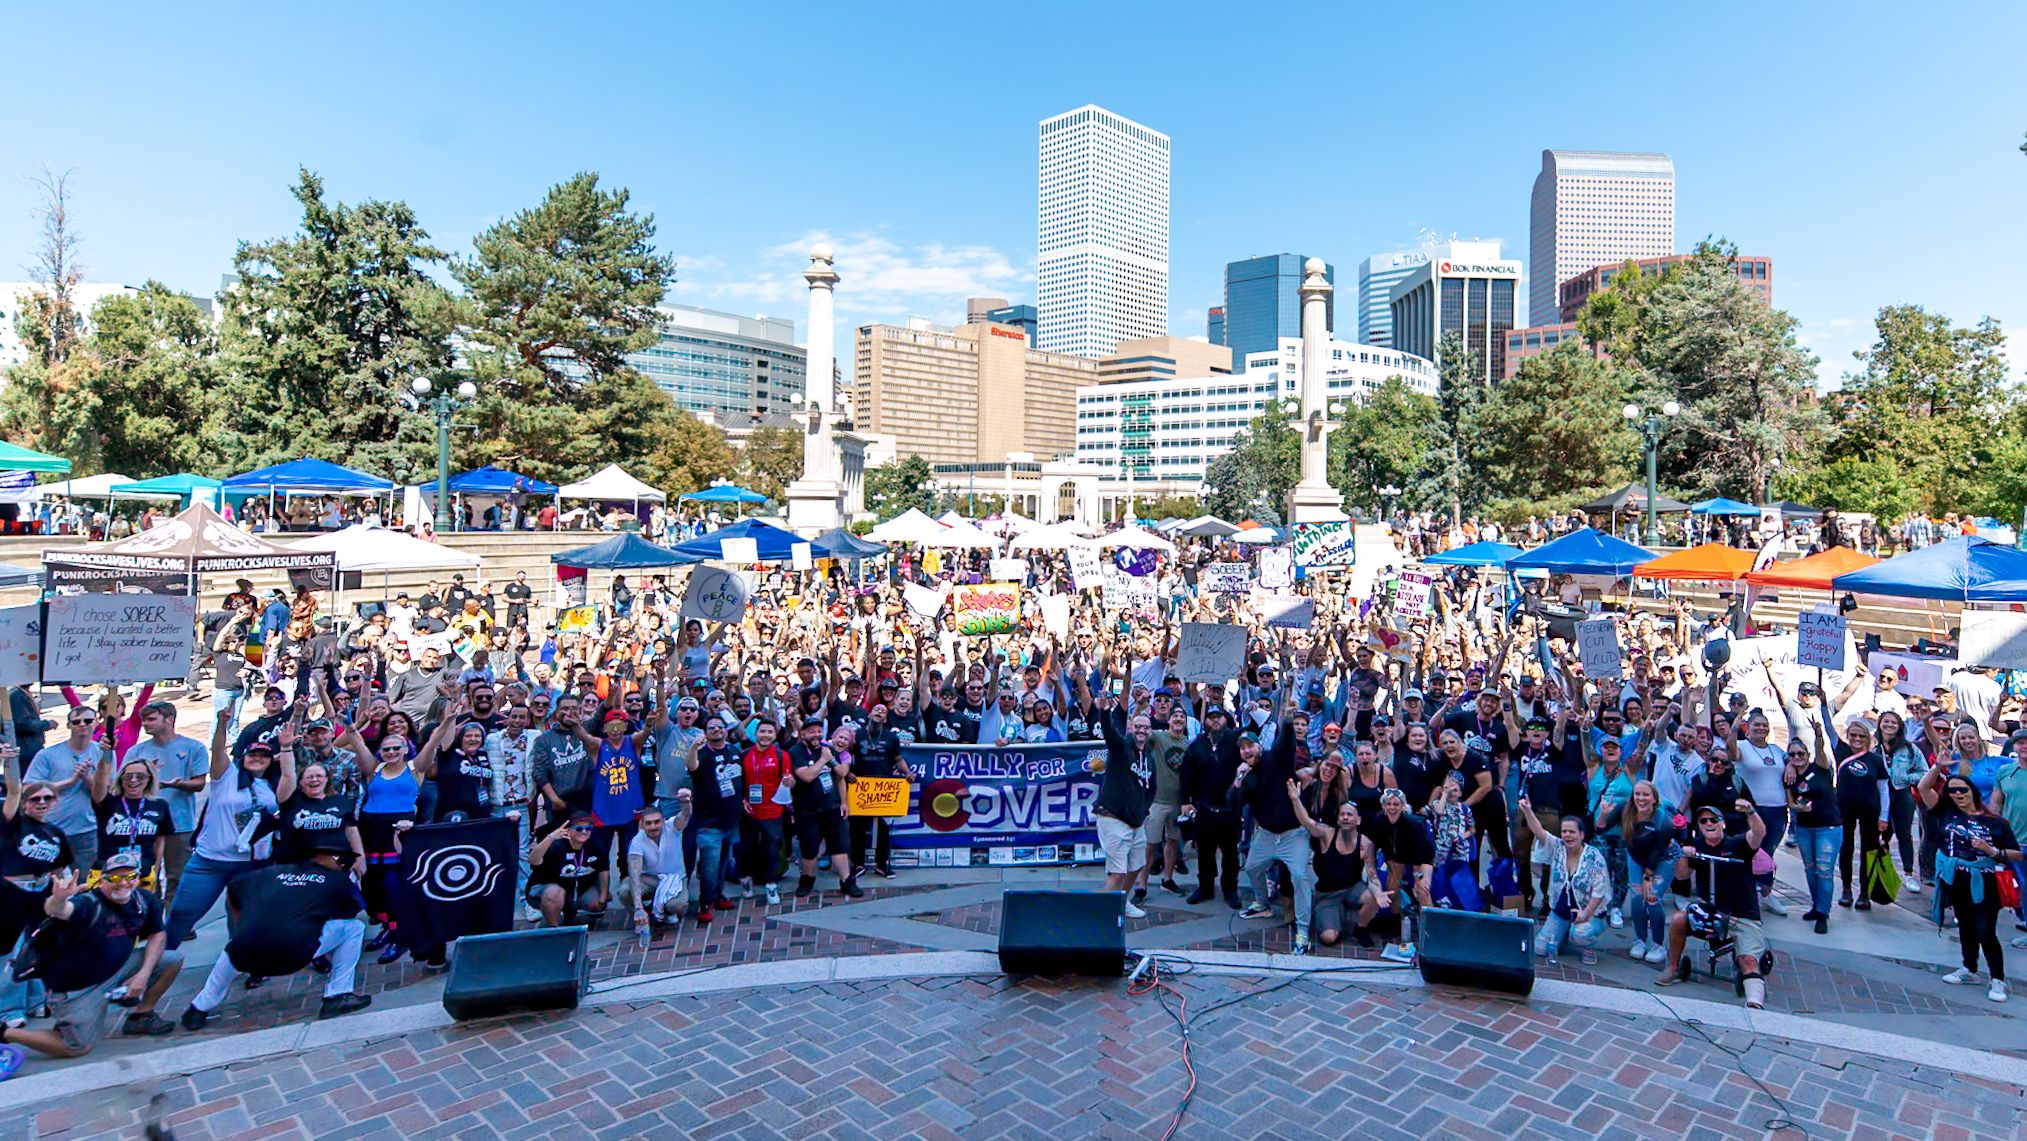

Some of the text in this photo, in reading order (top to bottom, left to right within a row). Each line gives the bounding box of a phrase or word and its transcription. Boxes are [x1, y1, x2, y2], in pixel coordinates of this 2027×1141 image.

[1403, 251, 1429, 265] TIAA
[1452, 264, 1517, 274] BOK FINANCIAL
[46, 552, 185, 570] PUNKROCKSAVESLIVES.ORG
[197, 555, 332, 571] PUNKROCKSAVESLIVES.ORG
[1210, 564, 1246, 575] SOBER
[703, 592, 738, 605] PEACE
[84, 608, 116, 622] chose
[120, 606, 166, 623] SOBER
[1801, 613, 1813, 624] I
[60, 624, 100, 635] because
[111, 624, 143, 635] wanted
[155, 625, 181, 635] better
[59, 637, 77, 648] life
[95, 637, 116, 654] stay
[120, 638, 148, 648] sober
[151, 638, 184, 648] because
[65, 652, 82, 666] got
[1586, 651, 1618, 667] LOUD
[600, 756, 636, 776] MILE HIGH
[934, 752, 1025, 779] RALLY
[1027, 758, 1066, 781] FOR
[609, 767, 627, 785] 23
[608, 784, 630, 795] CITY
[855, 781, 904, 792] NO MORE
[857, 790, 901, 805] SHAME!
[114, 824, 158, 835] RECVERY
